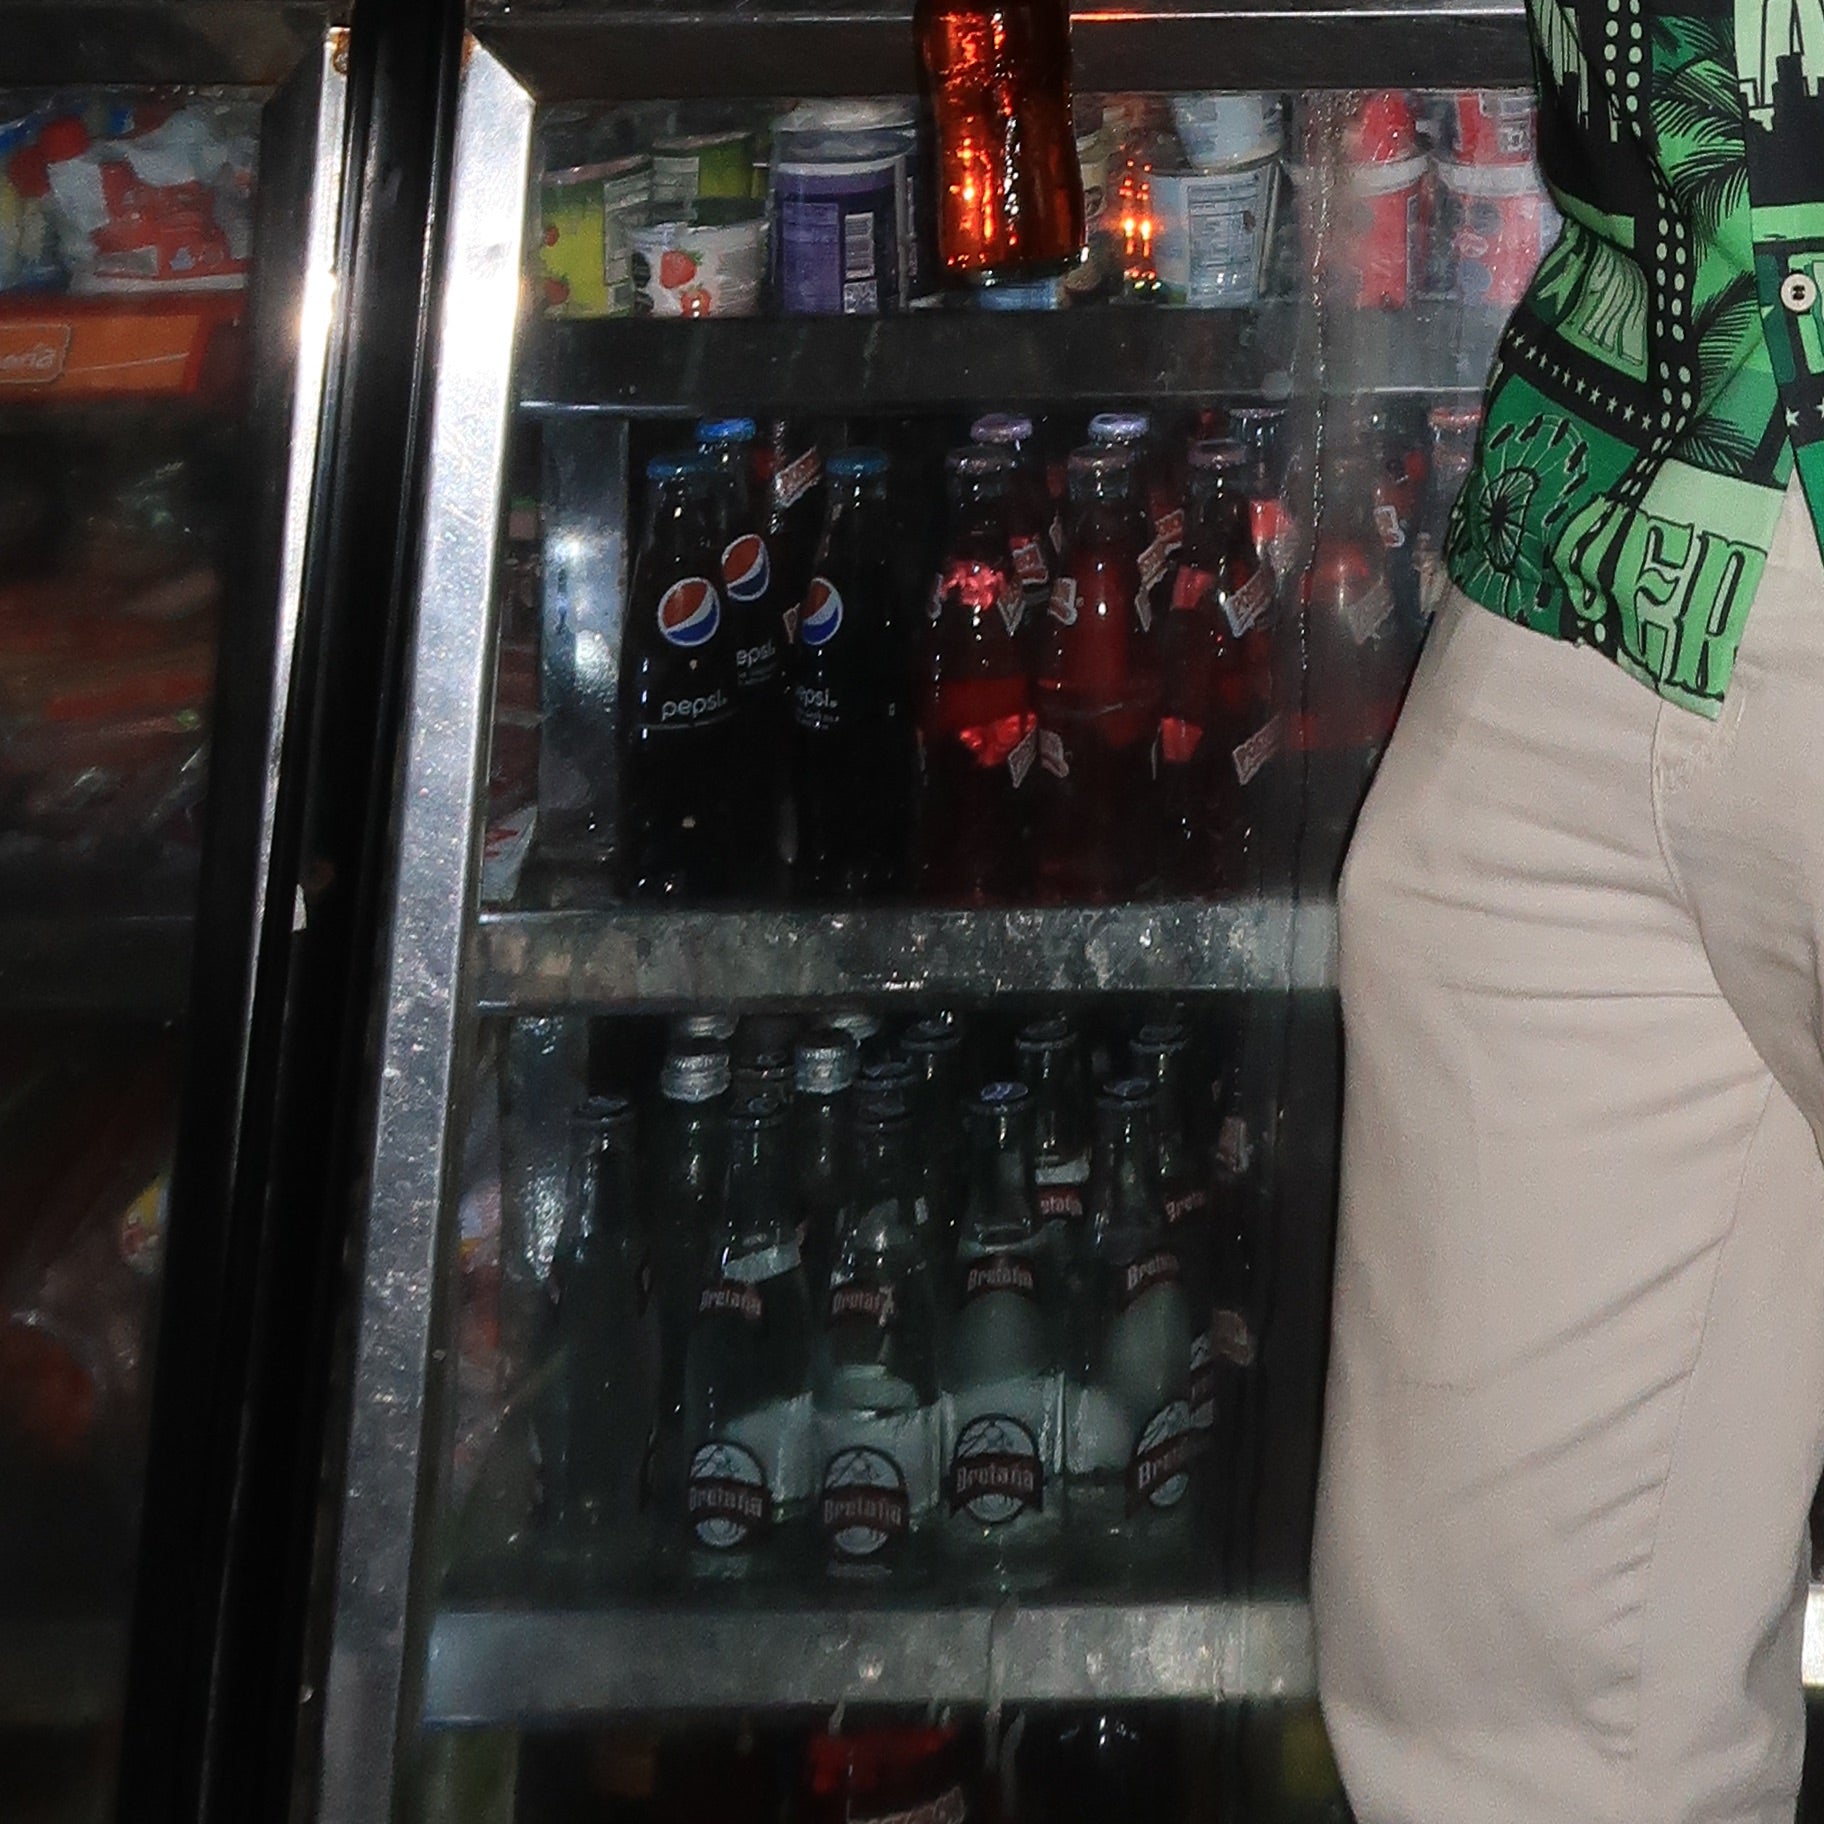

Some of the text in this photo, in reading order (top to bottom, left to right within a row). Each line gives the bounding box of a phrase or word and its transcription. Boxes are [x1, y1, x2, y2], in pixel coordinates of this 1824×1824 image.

[660, 689, 728, 722] pepsi
[966, 1260, 1036, 1294] Bretaña
[956, 1463, 1036, 1496] Bretaña
[822, 1496, 903, 1529] Bretaña
